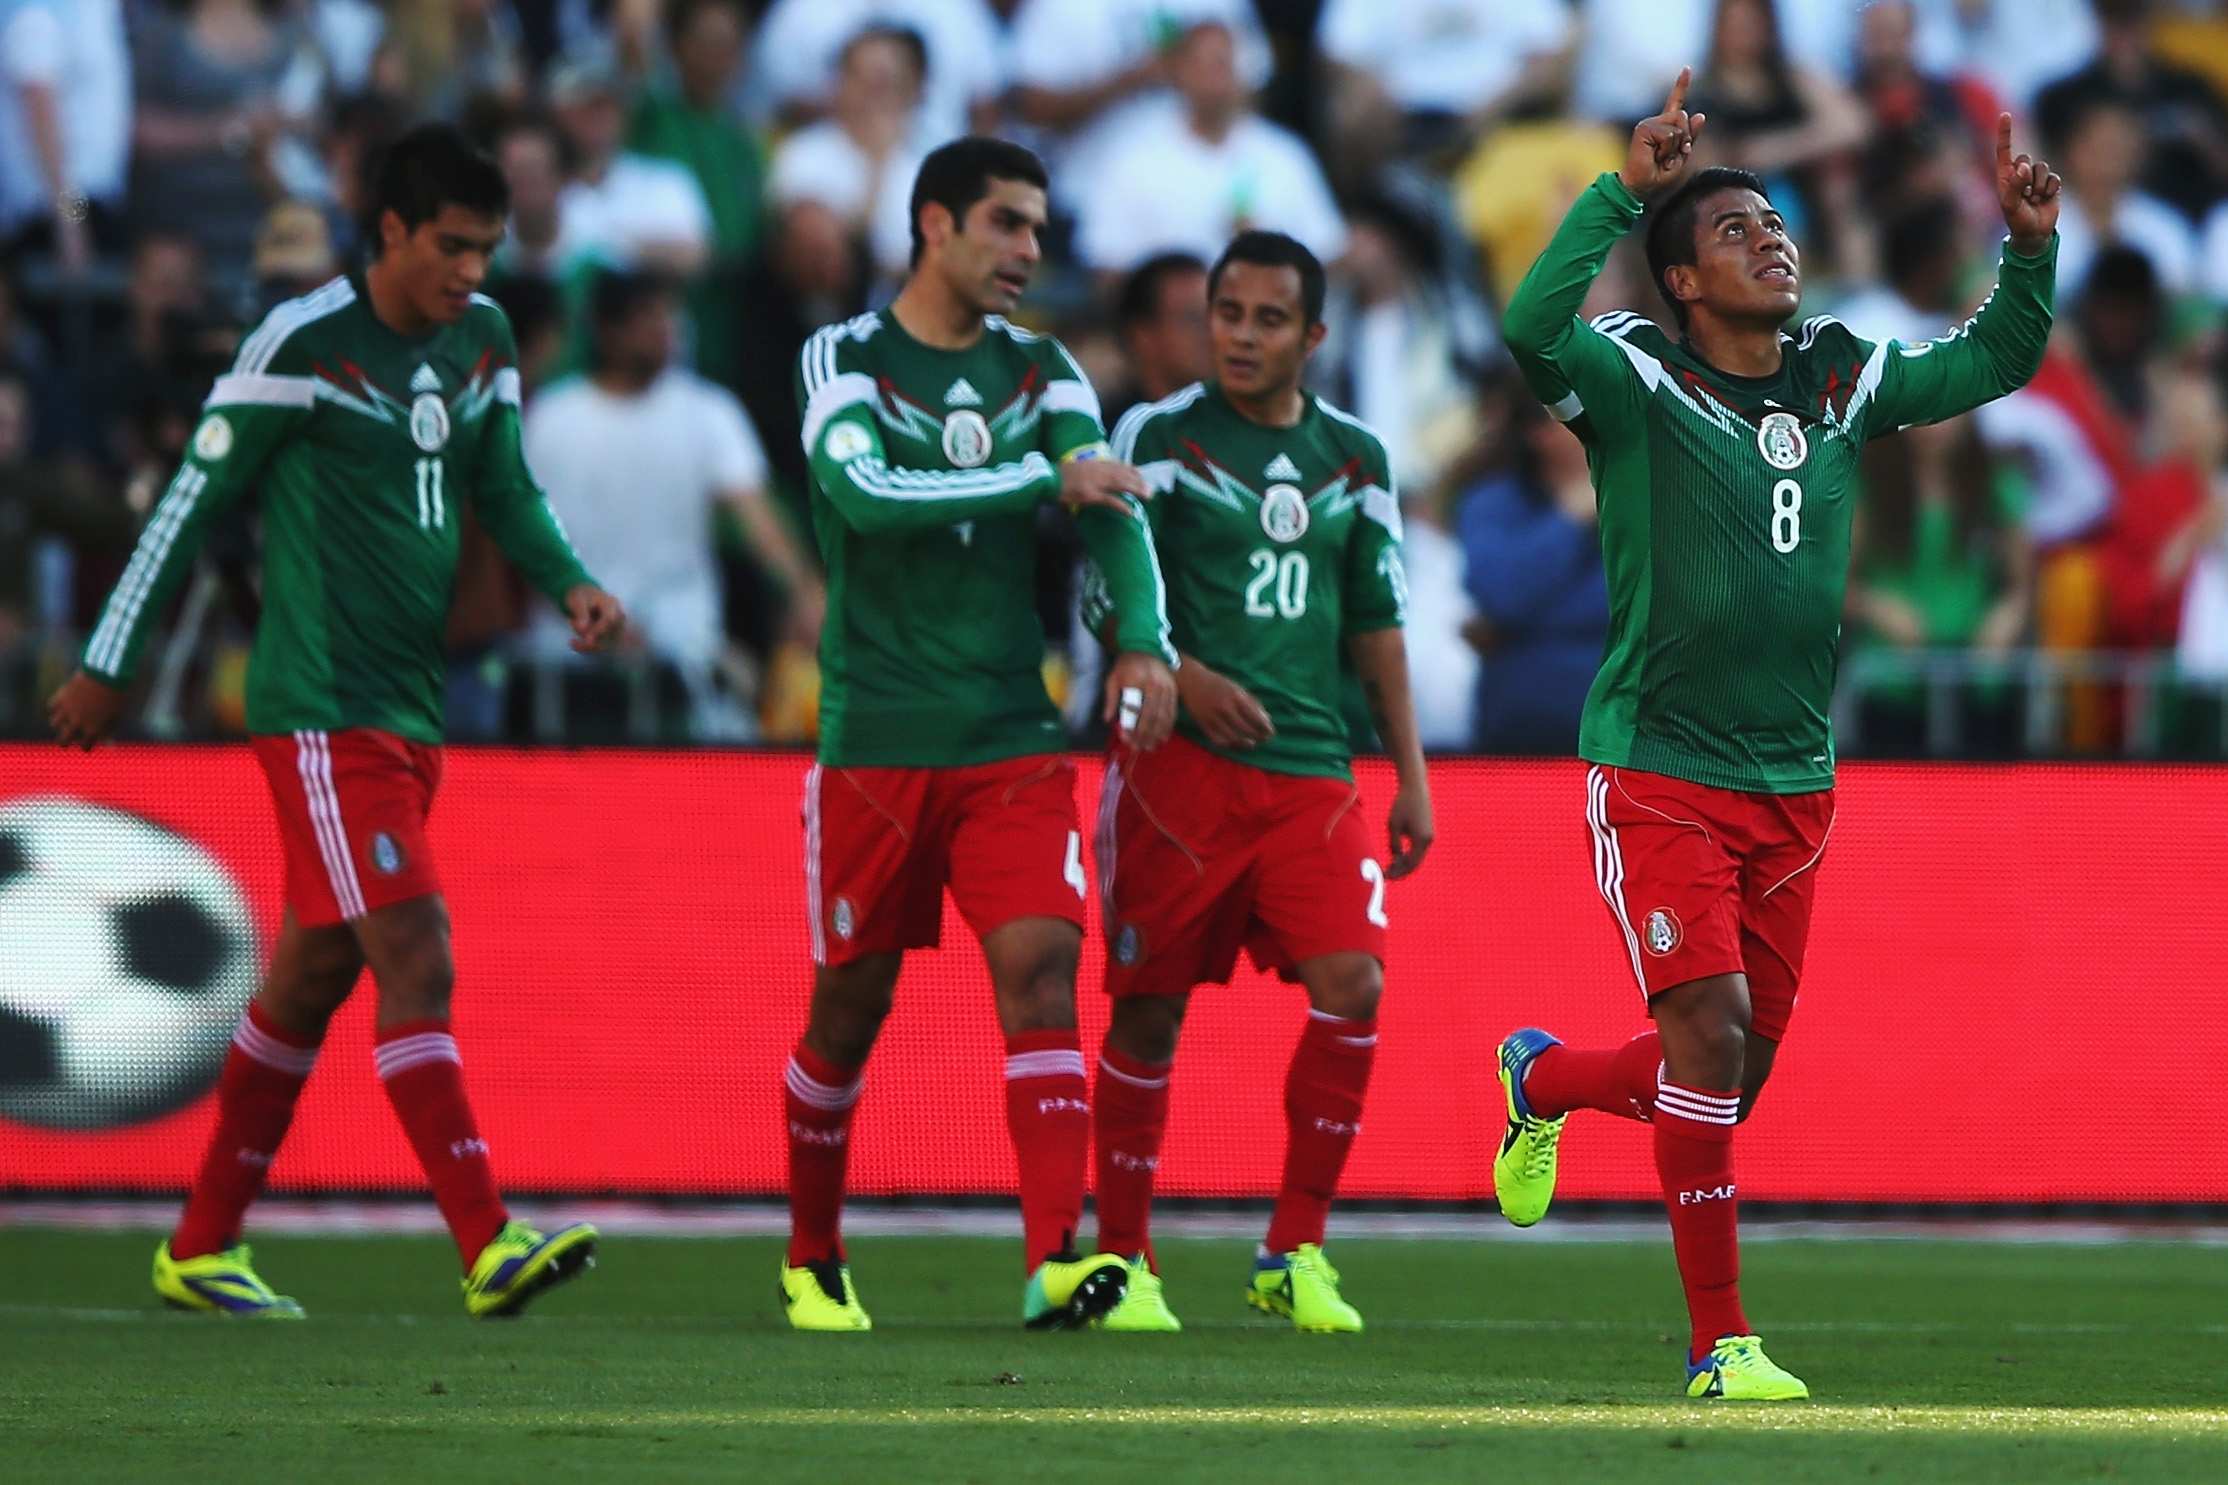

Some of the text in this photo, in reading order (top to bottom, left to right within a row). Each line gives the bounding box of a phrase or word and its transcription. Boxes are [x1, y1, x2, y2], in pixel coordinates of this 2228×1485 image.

[415, 457, 445, 529] 11
[1771, 478, 1802, 554] 8
[1244, 547, 1309, 620] 20
